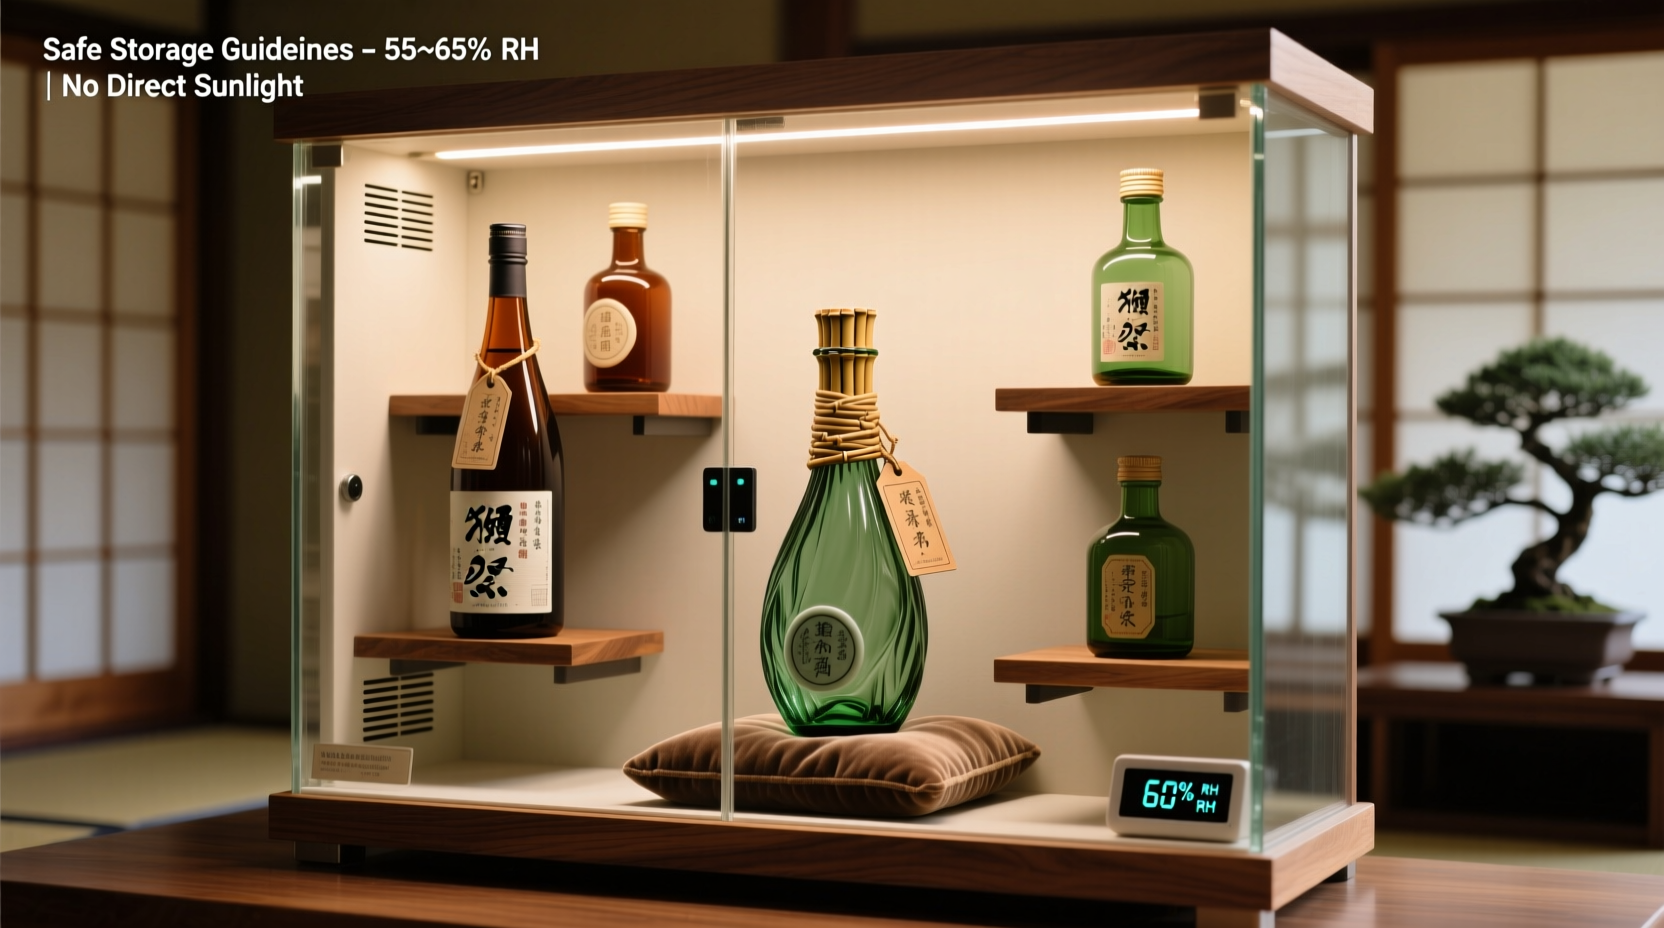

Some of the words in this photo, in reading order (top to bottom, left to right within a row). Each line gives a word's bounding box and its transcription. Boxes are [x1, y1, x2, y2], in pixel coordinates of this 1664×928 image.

[1142, 779, 1195, 810] 60%
[1201, 783, 1219, 796] RH
[1196, 799, 1217, 814] RH
